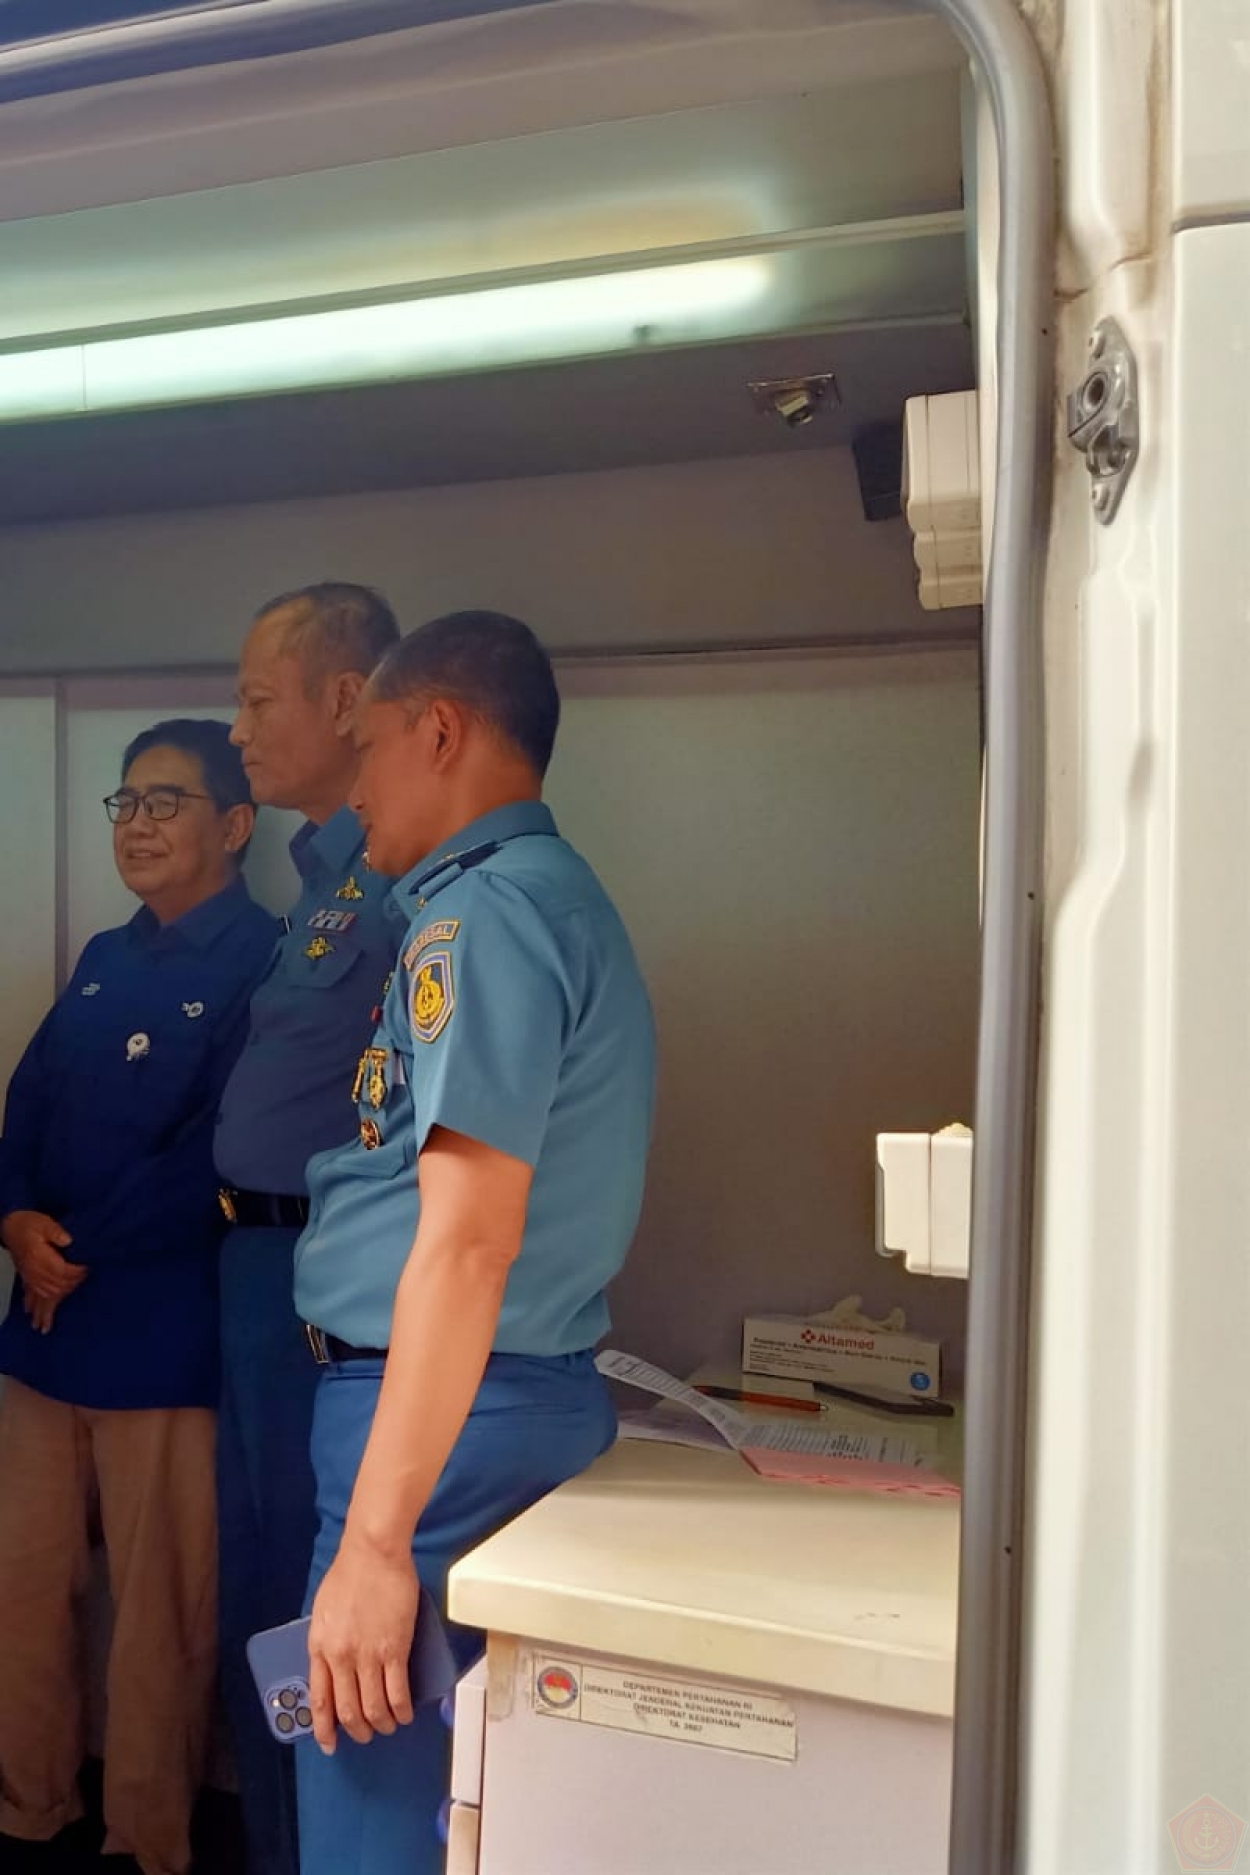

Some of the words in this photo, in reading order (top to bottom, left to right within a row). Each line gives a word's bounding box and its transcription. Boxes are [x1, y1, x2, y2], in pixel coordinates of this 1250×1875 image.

[817, 1332, 875, 1351] Altamed
[584, 1682, 637, 1700] DIREKTORAT
[623, 1680, 681, 1698] DEPARTEMEN
[682, 1691, 742, 1709] PERTAHANAN
[633, 1702, 686, 1718] DIREKTORAT
[688, 1712, 741, 1729] KESEHATAN
